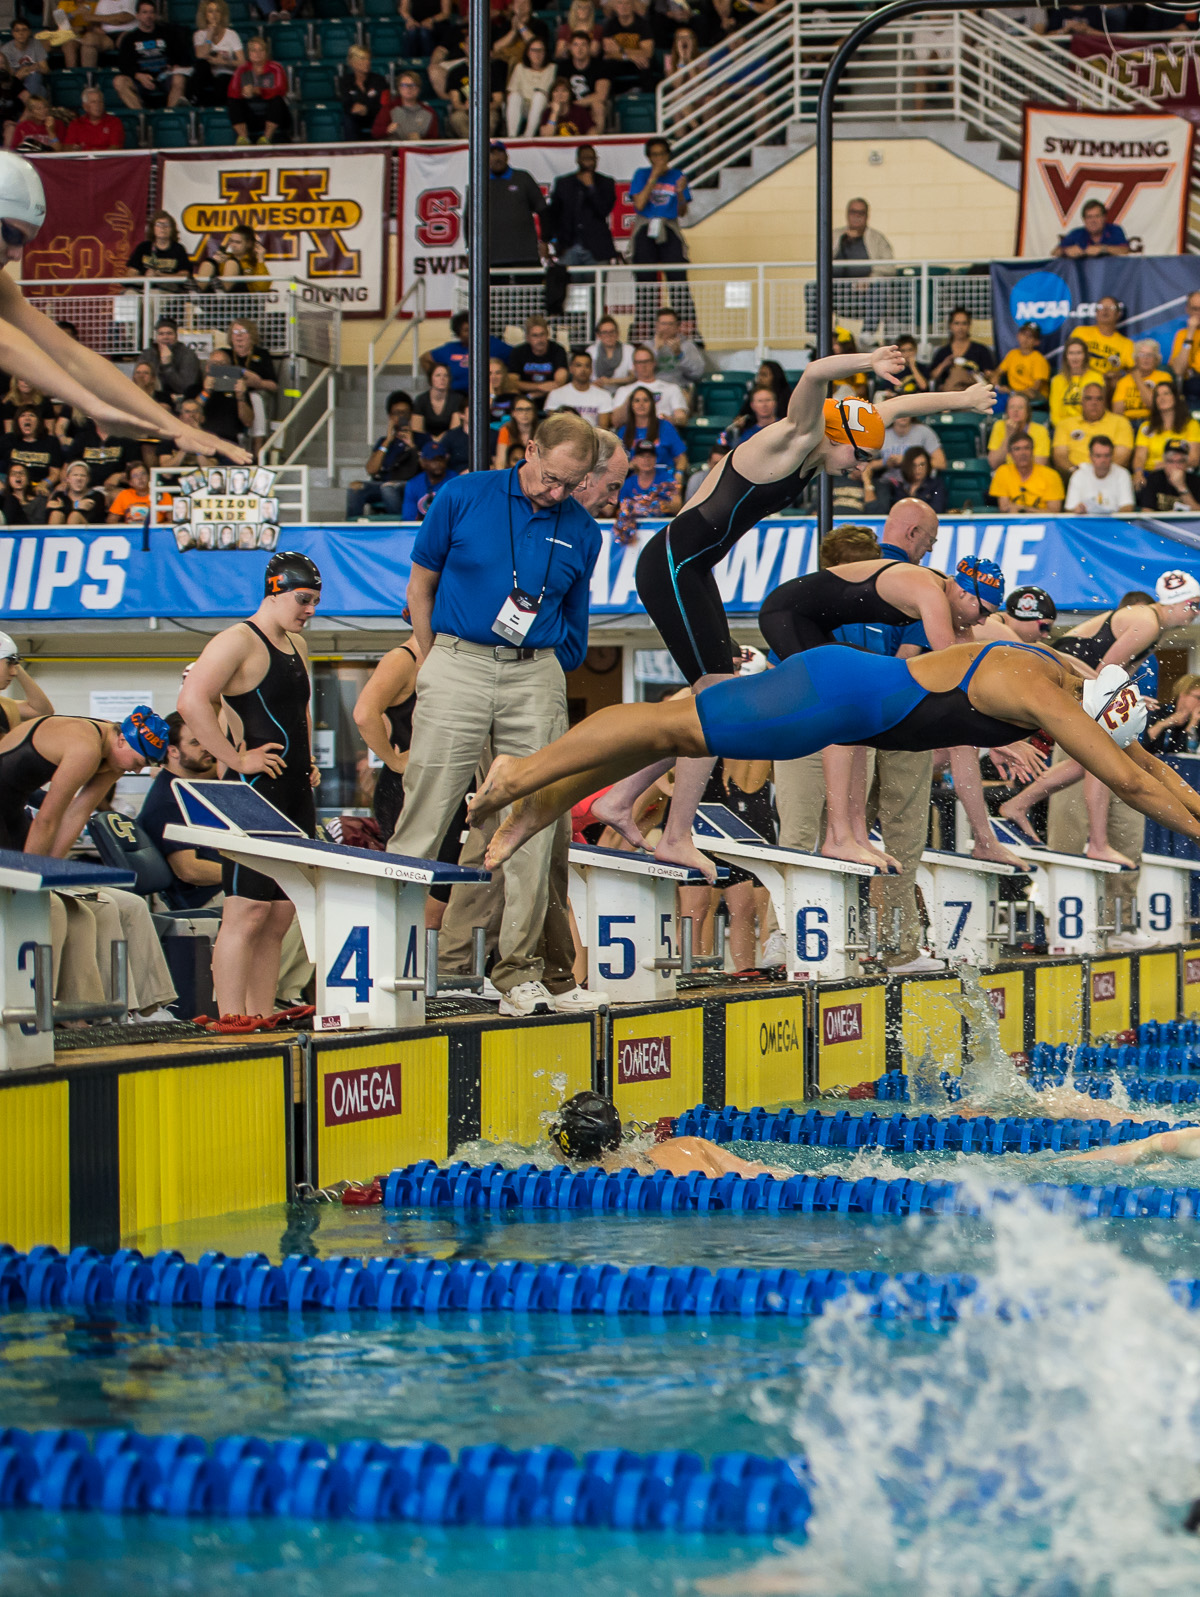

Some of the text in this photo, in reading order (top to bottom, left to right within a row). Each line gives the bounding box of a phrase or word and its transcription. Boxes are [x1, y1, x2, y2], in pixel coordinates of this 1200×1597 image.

[1043, 136, 1170, 158] SWIMMING
[196, 205, 348, 228] MINNESOTA
[302, 286, 369, 303] DIVING
[834, 399, 873, 432] T
[193, 499, 257, 509] MIZZOU
[203, 511, 246, 521] MADE
[268, 575, 284, 593] T
[395, 869, 428, 882] OMEGA
[657, 868, 684, 878] OMEGA
[943, 901, 973, 950] 7
[1058, 896, 1083, 939] 8
[1149, 893, 1172, 931] 9
[597, 914, 636, 980] 5
[660, 913, 672, 979] 5
[796, 906, 829, 962] 6
[326, 925, 374, 1003] 4
[402, 925, 417, 1001] 4
[760, 1018, 799, 1055] OMEGA
[827, 1009, 859, 1040] OMEGA
[622, 1041, 670, 1077] OMEGA
[331, 1070, 396, 1117] OMEGA
